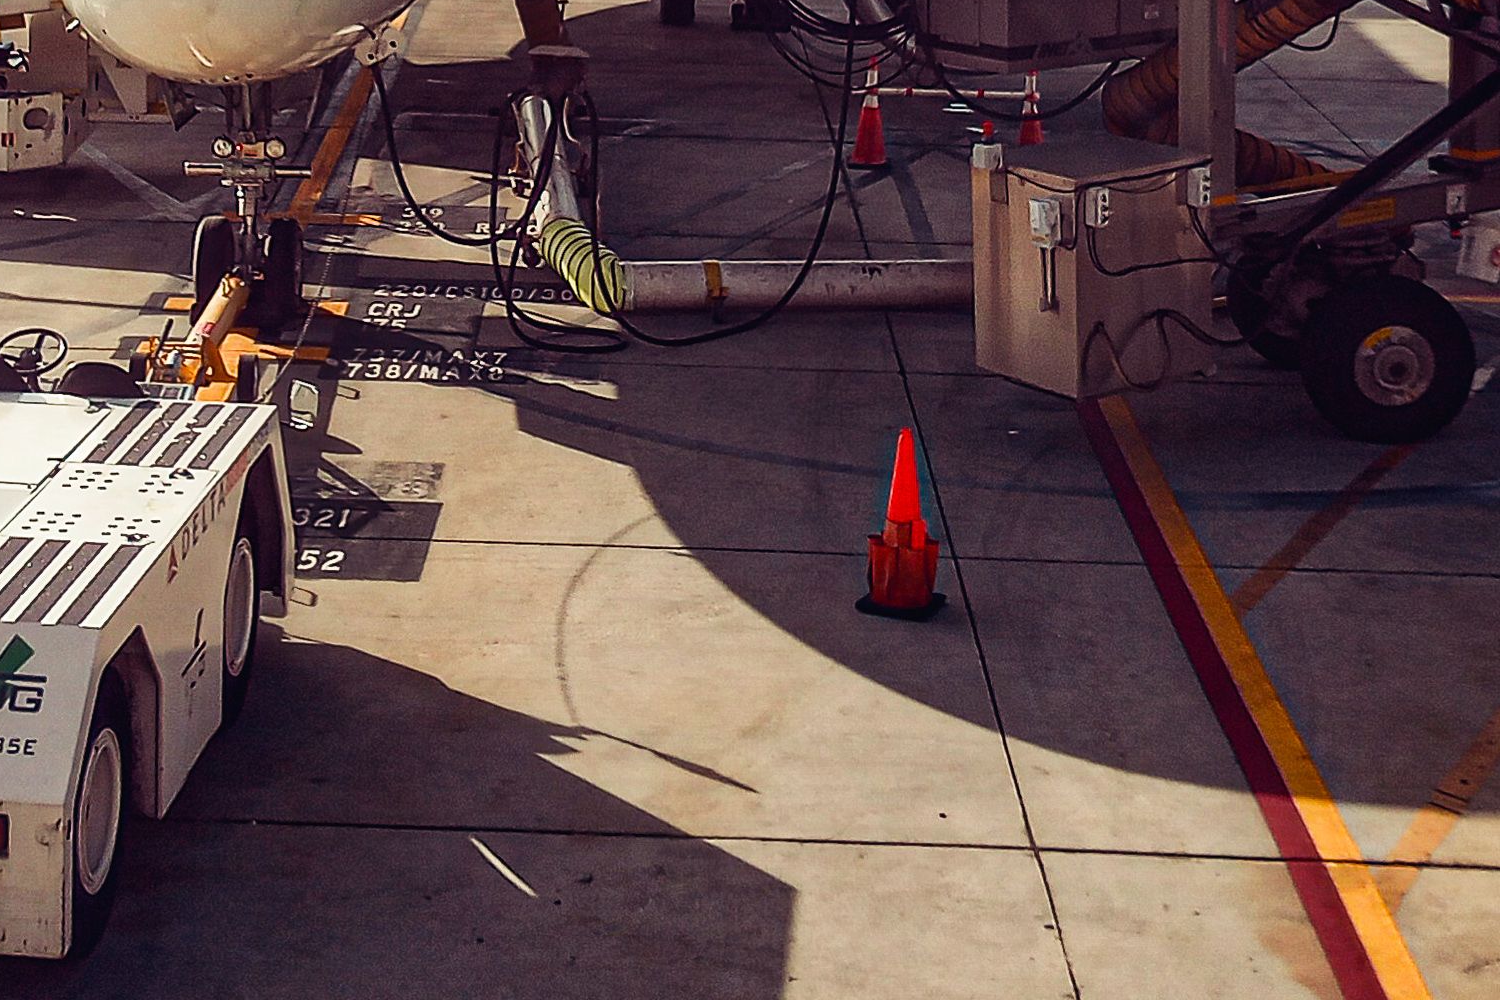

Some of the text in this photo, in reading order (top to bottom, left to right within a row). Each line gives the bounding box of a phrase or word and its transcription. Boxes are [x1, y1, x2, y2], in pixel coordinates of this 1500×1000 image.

[367, 302, 423, 319] CRJ
[181, 481, 226, 561] DELTA
[295, 549, 345, 572] 52
